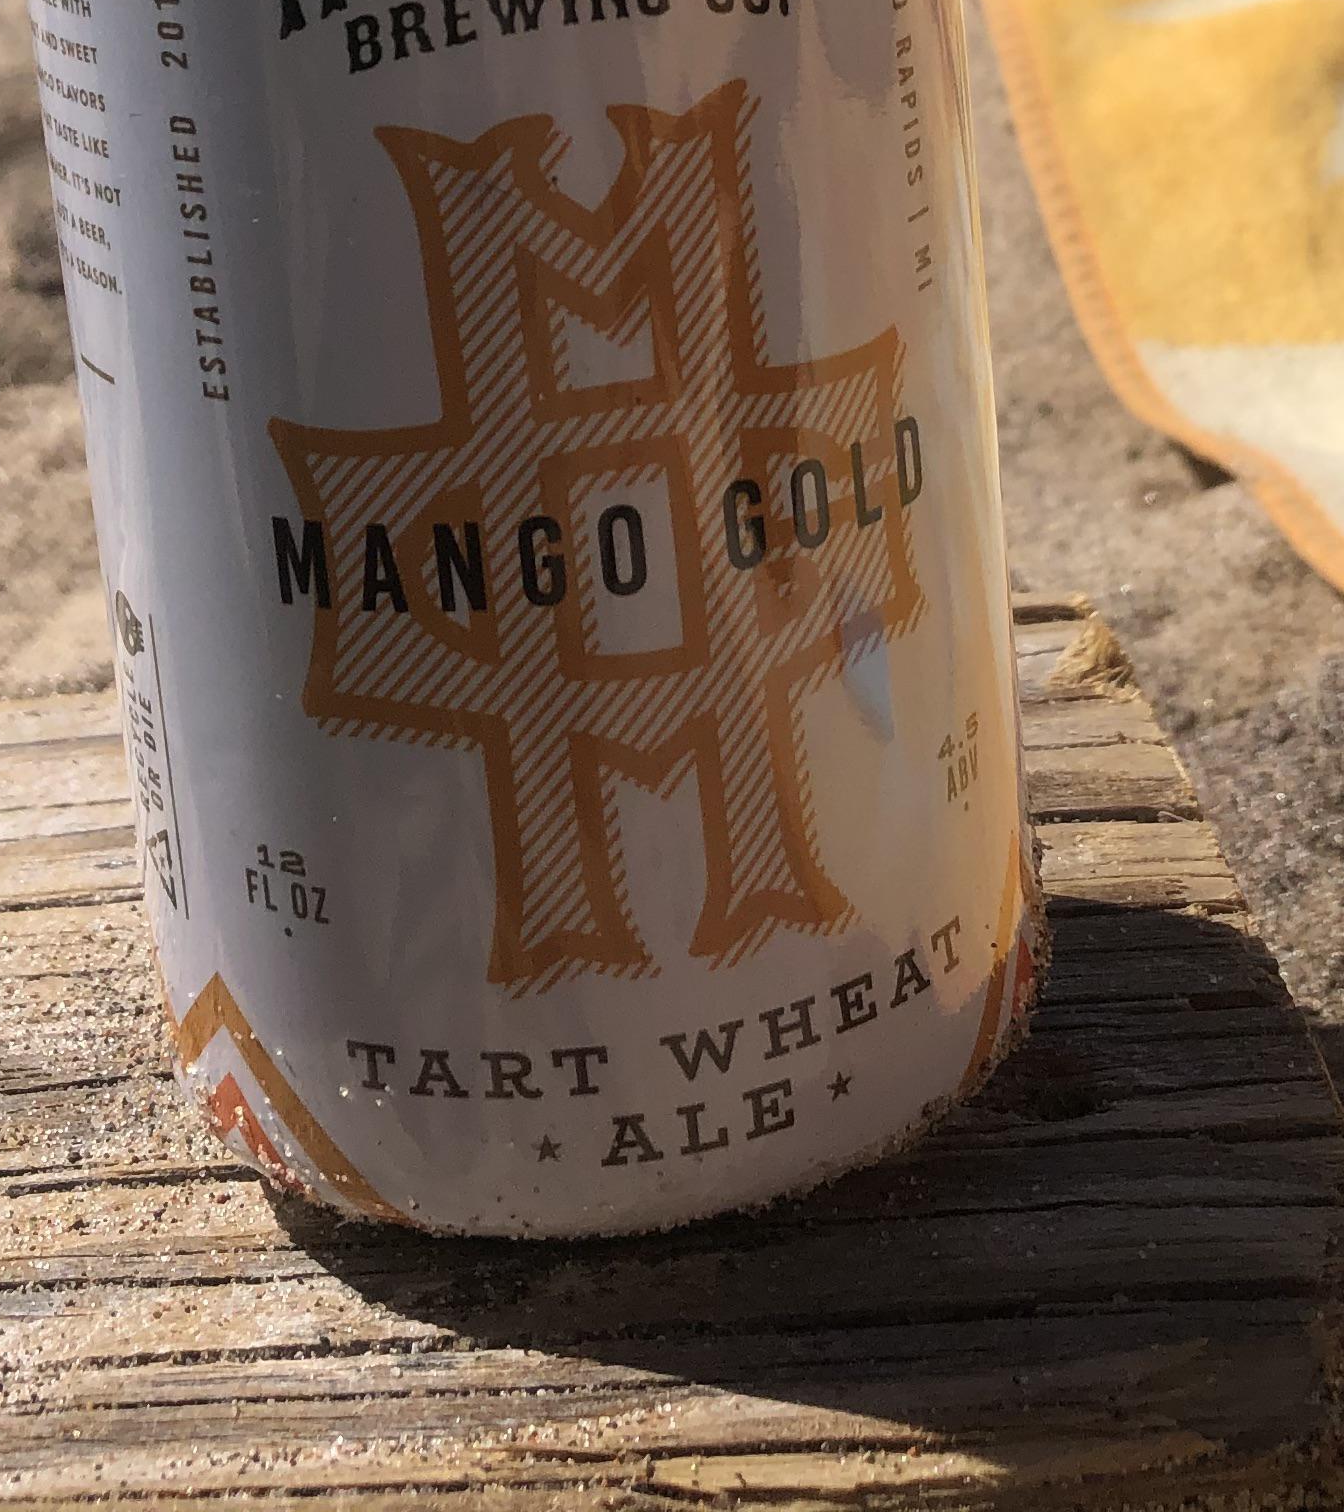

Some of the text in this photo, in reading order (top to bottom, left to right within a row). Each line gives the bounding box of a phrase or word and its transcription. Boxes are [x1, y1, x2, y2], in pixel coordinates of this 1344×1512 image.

[59, 37, 98, 65] SWEET
[56, 78, 106, 113] FLAVORS
[53, 119, 80, 149] TASTE
[81, 132, 109, 159] LIKE
[895, 35, 924, 187] RAPIDS
[914, 243, 934, 292] MI
[94, 182, 122, 207] NOT
[79, 217, 111, 251] BEER,
[169, 115, 230, 402] ESTABLISHED
[76, 257, 123, 295] SEASON.
[270, 415, 924, 614] MANGO GOLD
[122, 661, 151, 814] RECYCLE
[138, 695, 165, 812] OR DIE
[946, 742, 978, 804] ABV
[256, 843, 307, 878] 12
[245, 867, 330, 925] FL OZ
[346, 916, 962, 1100] TART WHEAT
[600, 1077, 797, 1168] ALE
